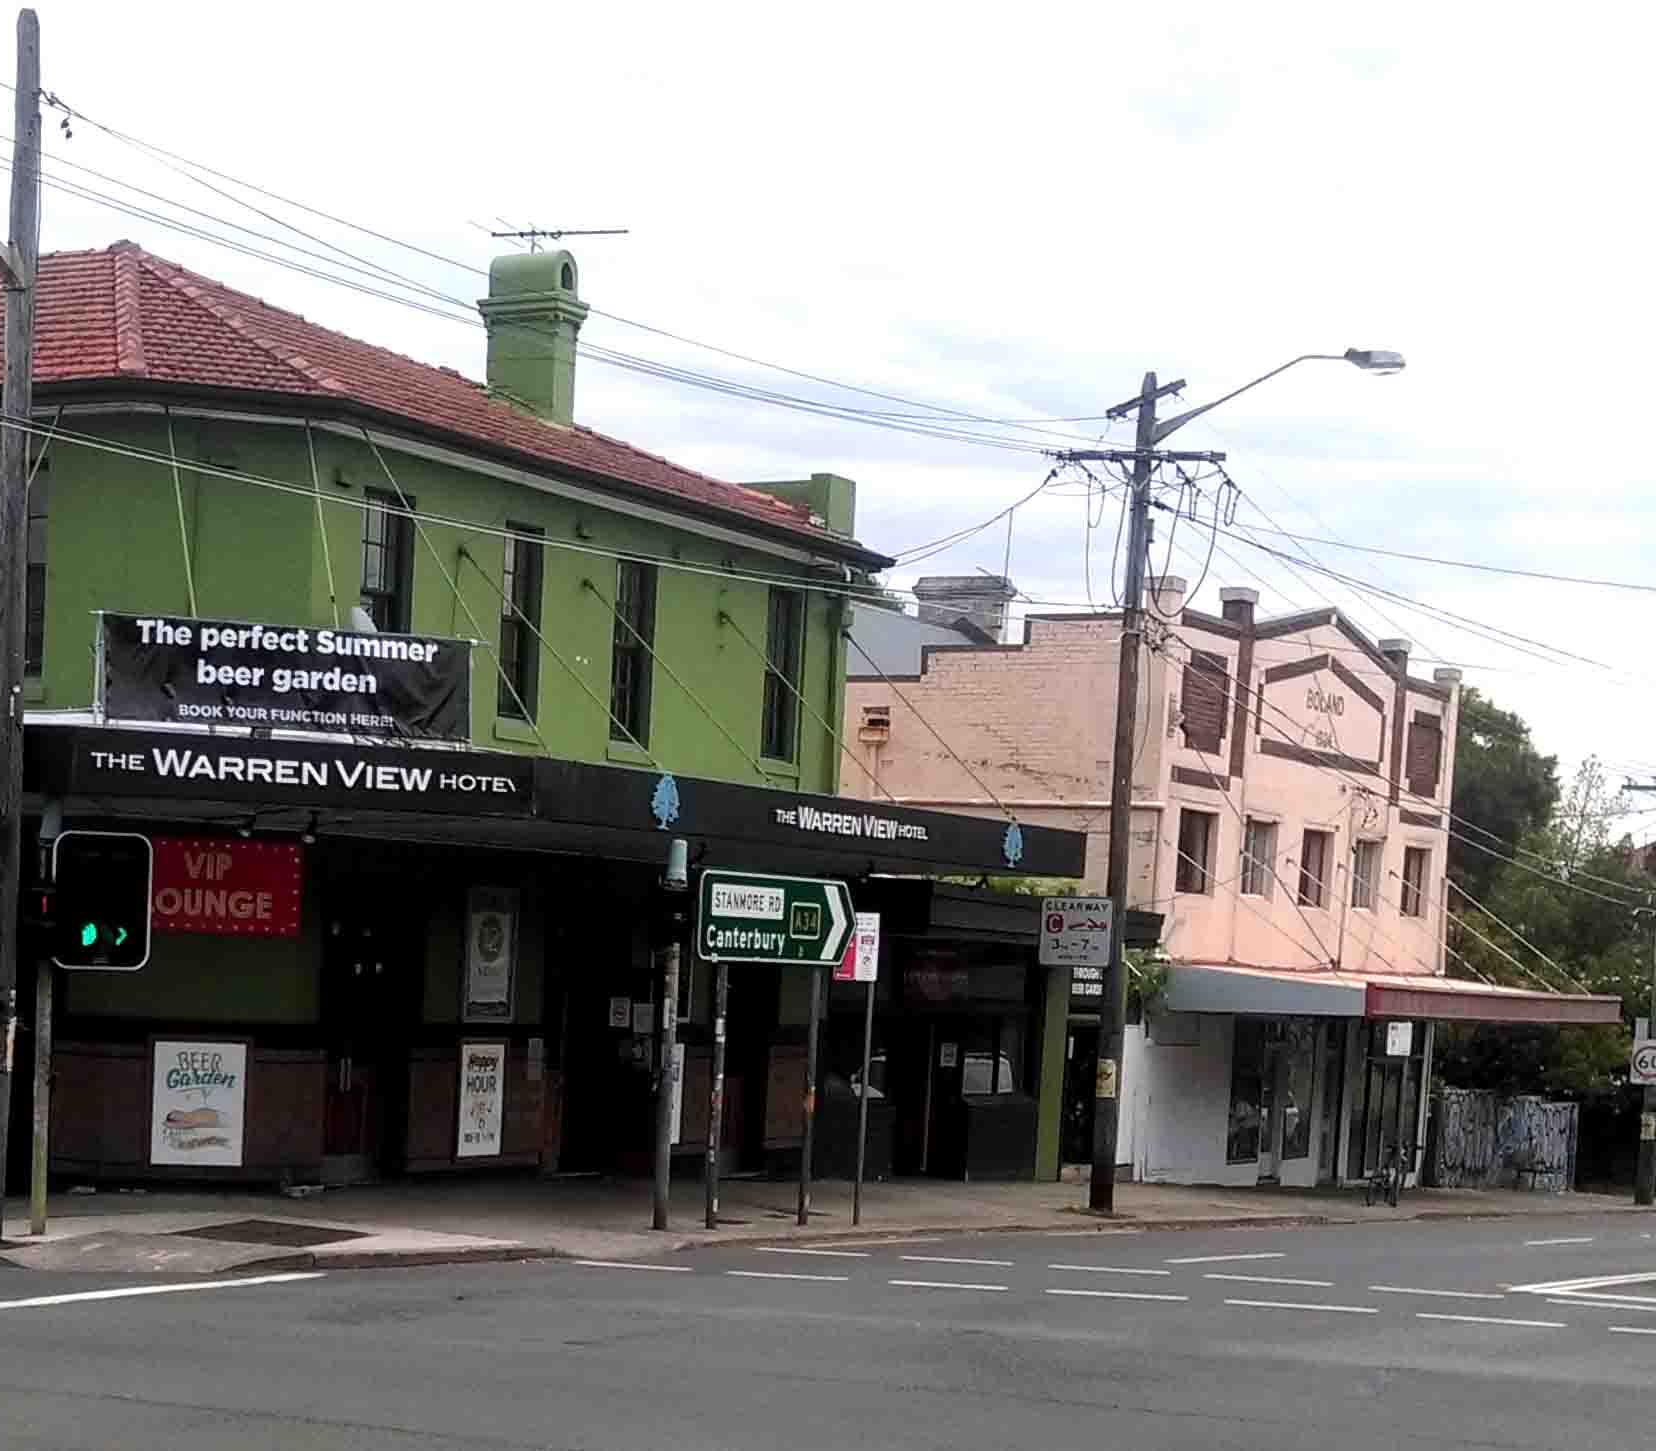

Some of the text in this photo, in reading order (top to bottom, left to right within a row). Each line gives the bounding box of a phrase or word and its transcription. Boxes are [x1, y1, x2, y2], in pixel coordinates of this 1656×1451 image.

[137, 619, 439, 662] The perfect Summer
[196, 659, 377, 694] beer garden
[178, 703, 222, 719] BOOK
[227, 705, 268, 721] YOUR
[270, 708, 347, 725] FUNCTION
[91, 750, 144, 771] THE
[152, 747, 329, 787] WARREN
[334, 759, 432, 793] VIEW
[775, 805, 929, 841] THE WARREN VIEW HOTEL
[184, 851, 233, 880] VIP
[151, 887, 273, 919] OUNGE
[713, 891, 782, 913] STANMORE RD
[1046, 901, 1108, 912] CLEARWAY
[794, 910, 818, 932] A34
[706, 923, 786, 956] Canterbury
[176, 1050, 224, 1072] BEER
[166, 1067, 237, 1089] Garden
[466, 1074, 497, 1095] HOUR
